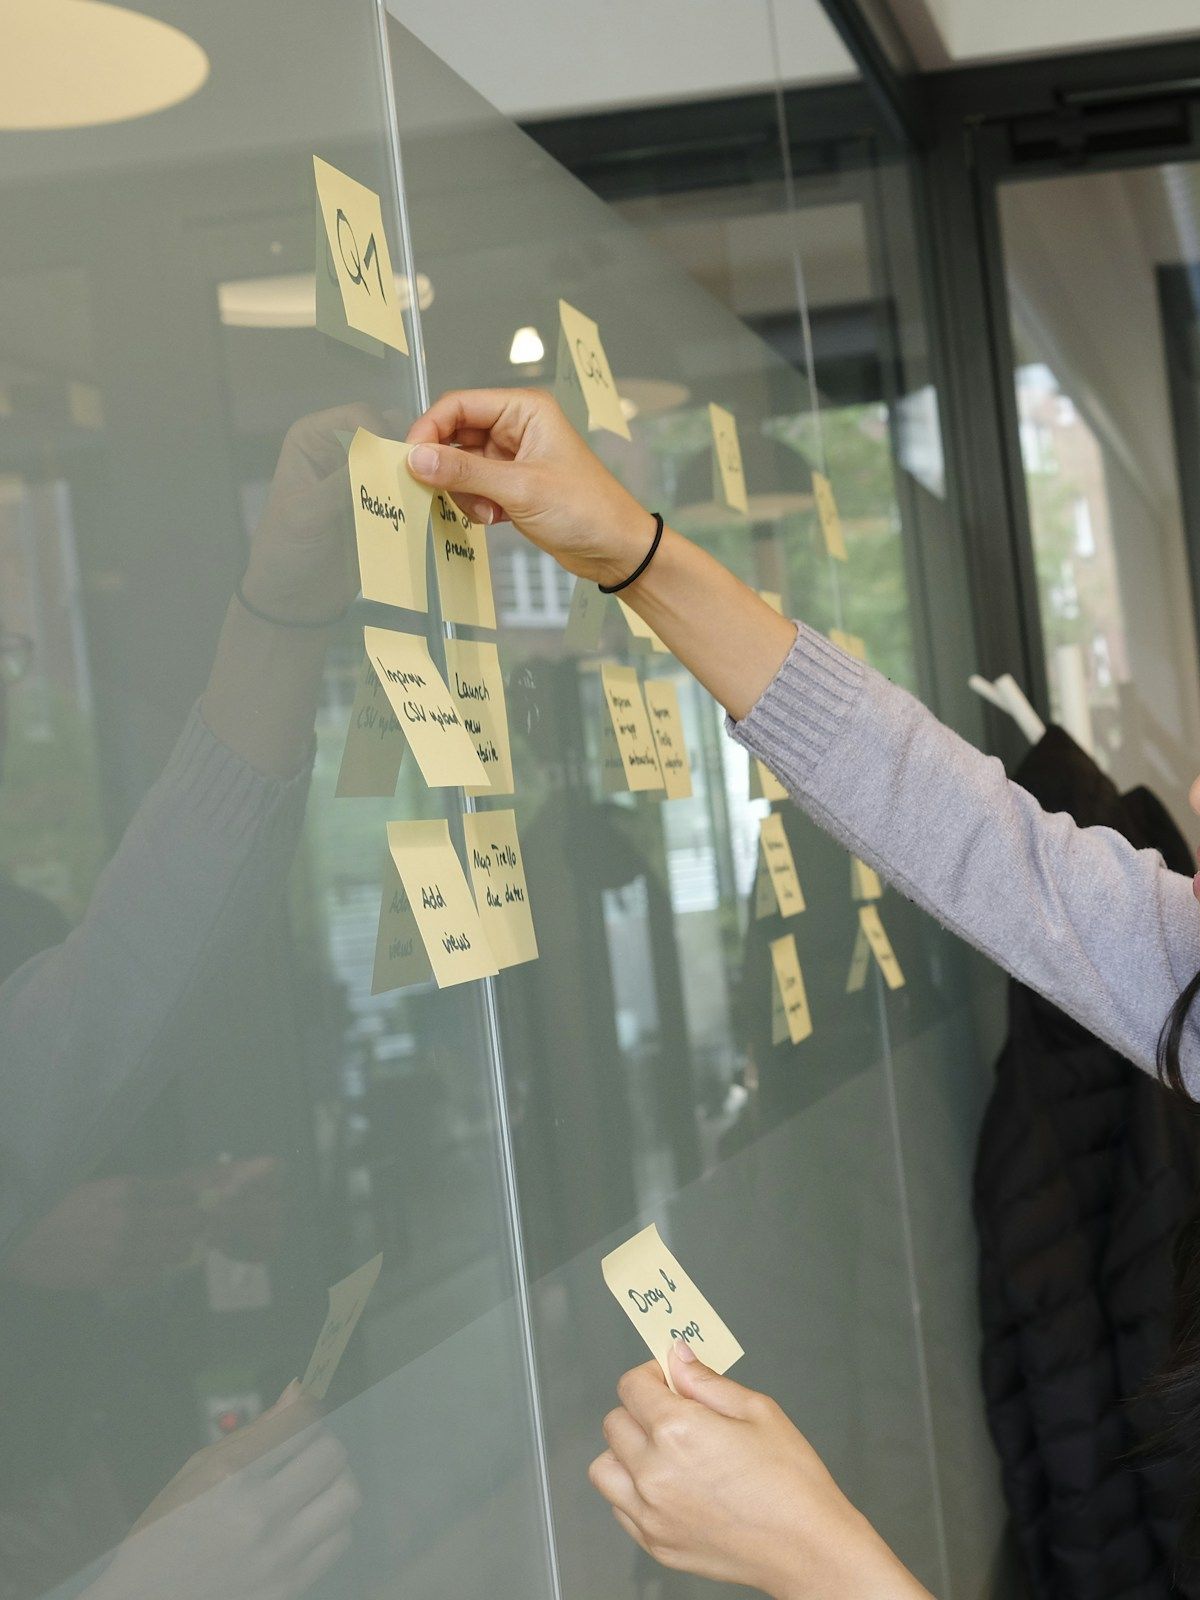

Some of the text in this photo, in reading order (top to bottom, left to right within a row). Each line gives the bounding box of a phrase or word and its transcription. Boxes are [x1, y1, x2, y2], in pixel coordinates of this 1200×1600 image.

[337, 208, 387, 306] Q1
[361, 484, 405, 532] Redesign
[445, 539, 476, 561] premise
[376, 656, 426, 693] Improve
[455, 672, 490, 702] Launch
[403, 701, 427, 724] CSV
[429, 705, 462, 733] upload
[464, 719, 481, 734] new
[473, 843, 517, 877] Map Trello
[421, 884, 448, 910] Add
[486, 883, 525, 908] due dates
[442, 931, 472, 954] views
[628, 1288, 673, 1315] Drag
